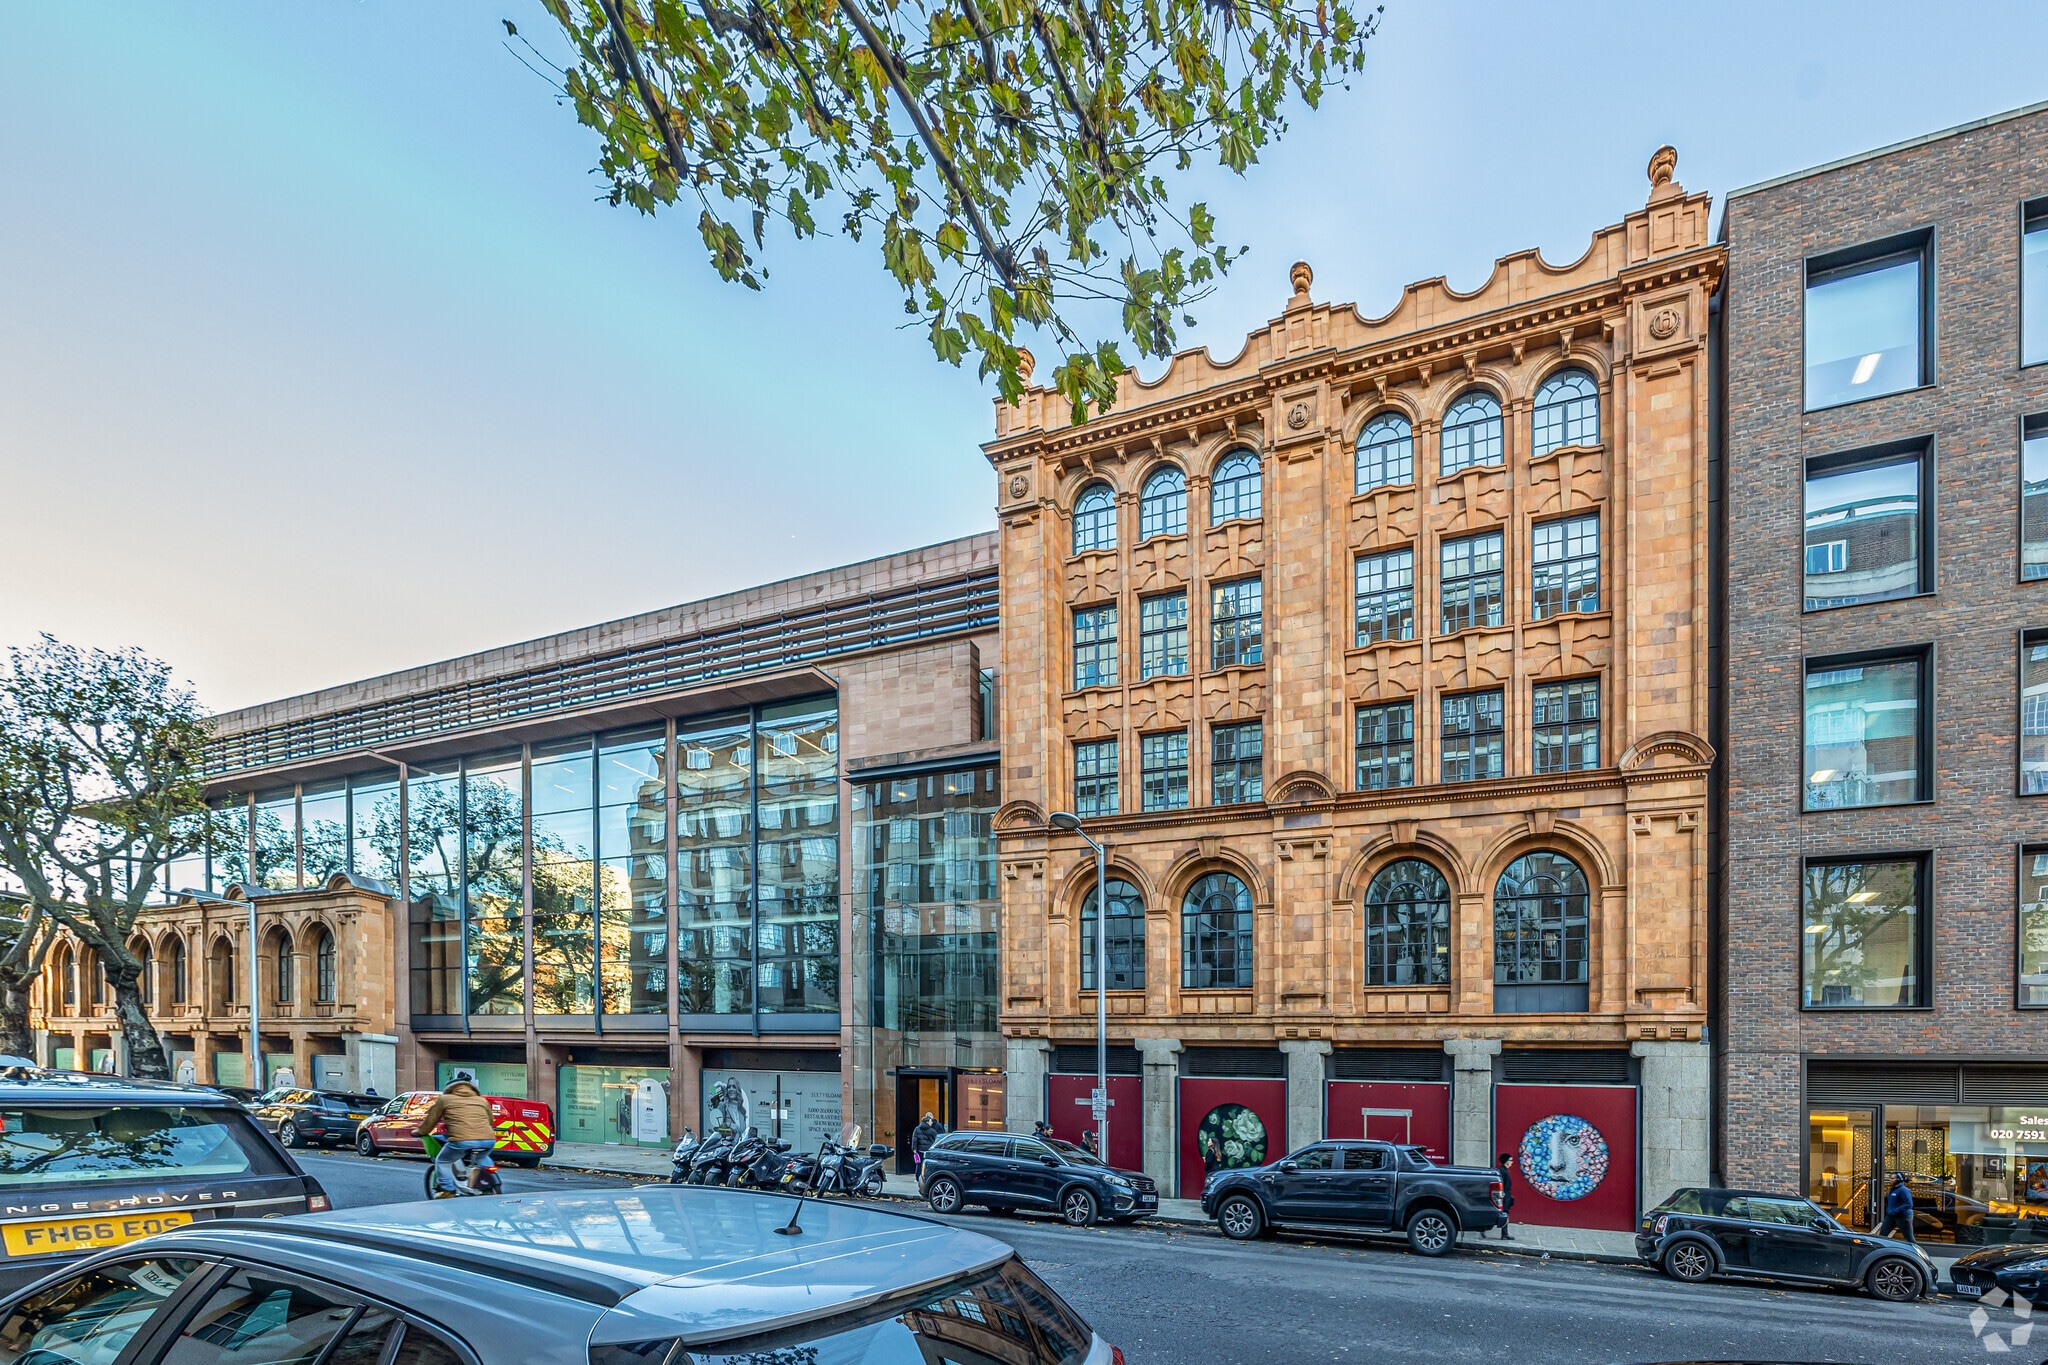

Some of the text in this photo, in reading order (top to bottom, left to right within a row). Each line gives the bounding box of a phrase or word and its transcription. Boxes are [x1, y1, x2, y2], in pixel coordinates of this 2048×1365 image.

[2020, 1116, 2048, 1125] Sales
[1991, 1130, 2047, 1140] 020 7591
[118, 1191, 238, 1206] ROVER
[24, 1223, 114, 1246] FH66
